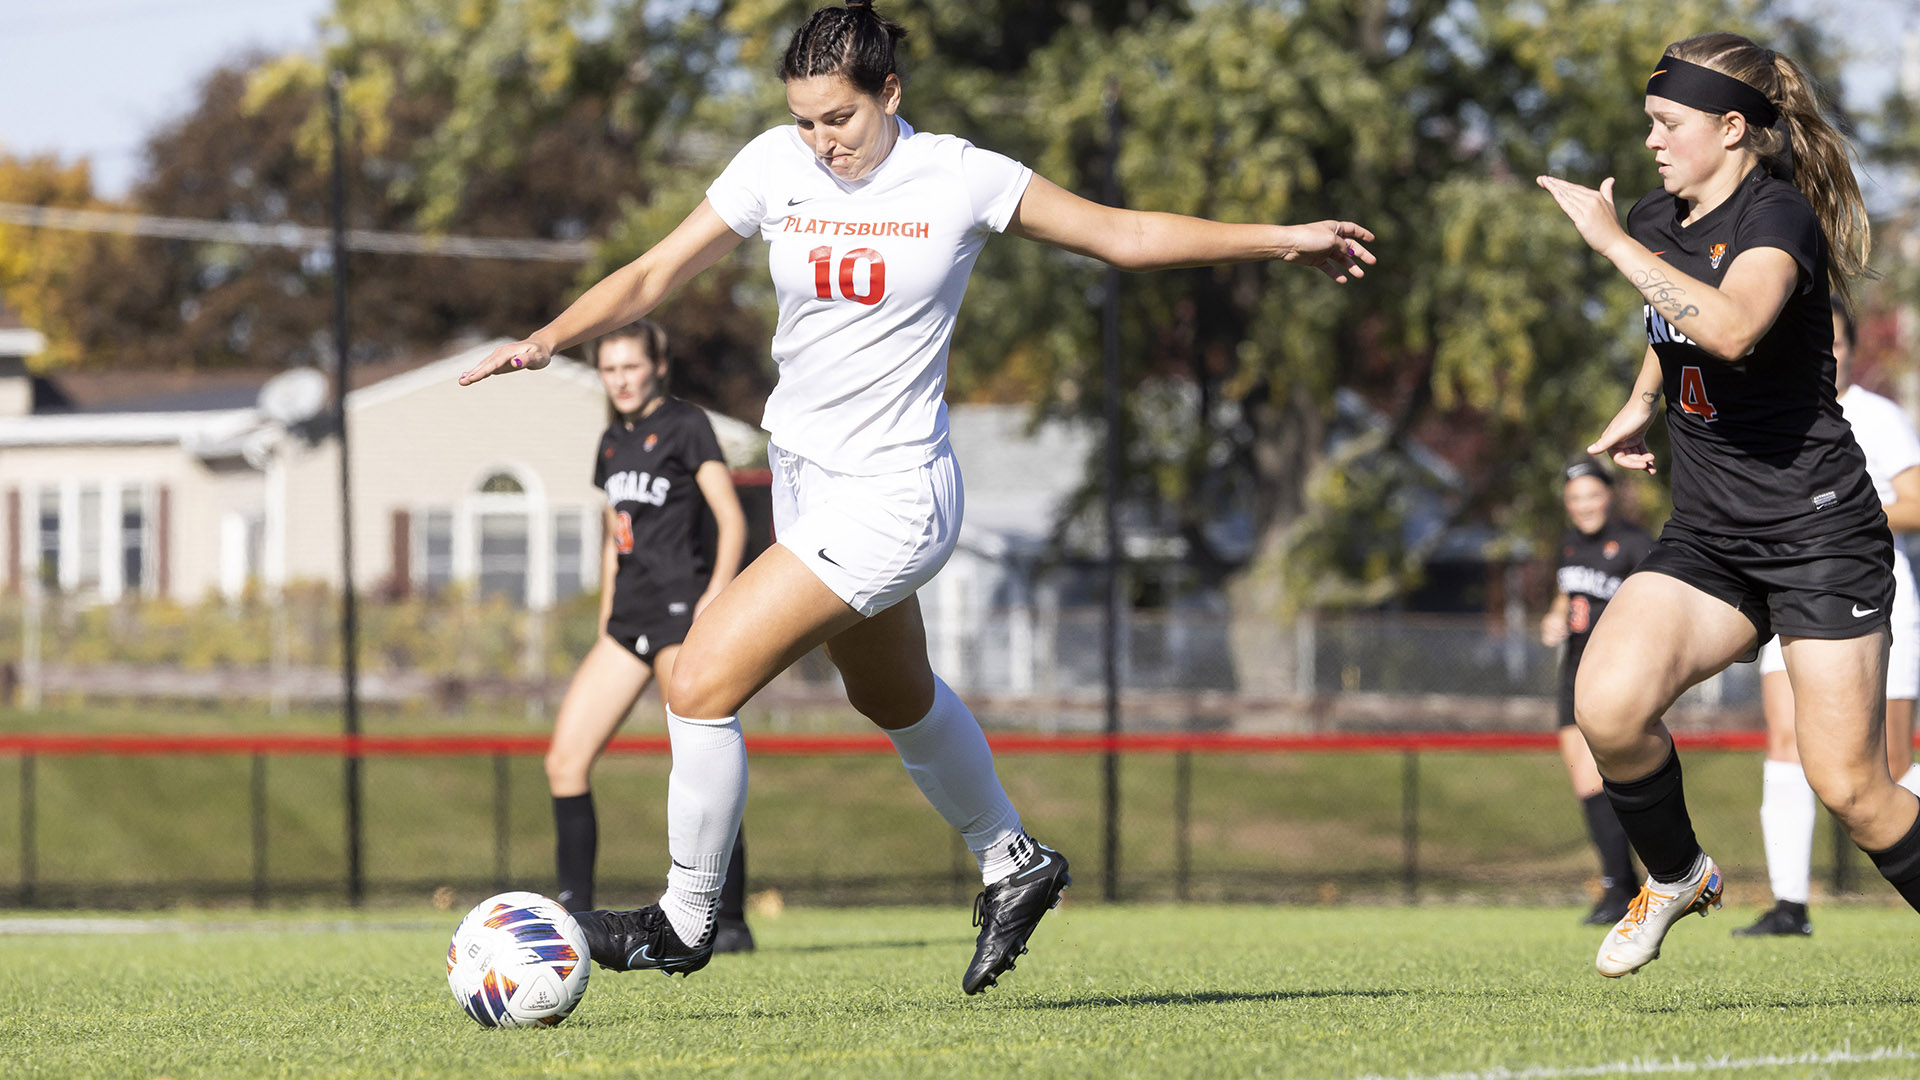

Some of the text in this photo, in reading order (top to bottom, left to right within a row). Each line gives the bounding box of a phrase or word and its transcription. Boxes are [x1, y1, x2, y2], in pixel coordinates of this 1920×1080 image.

[783, 216, 930, 239] PLATTSBURGH
[808, 245, 886, 306] 10
[1680, 365, 1719, 423] 4
